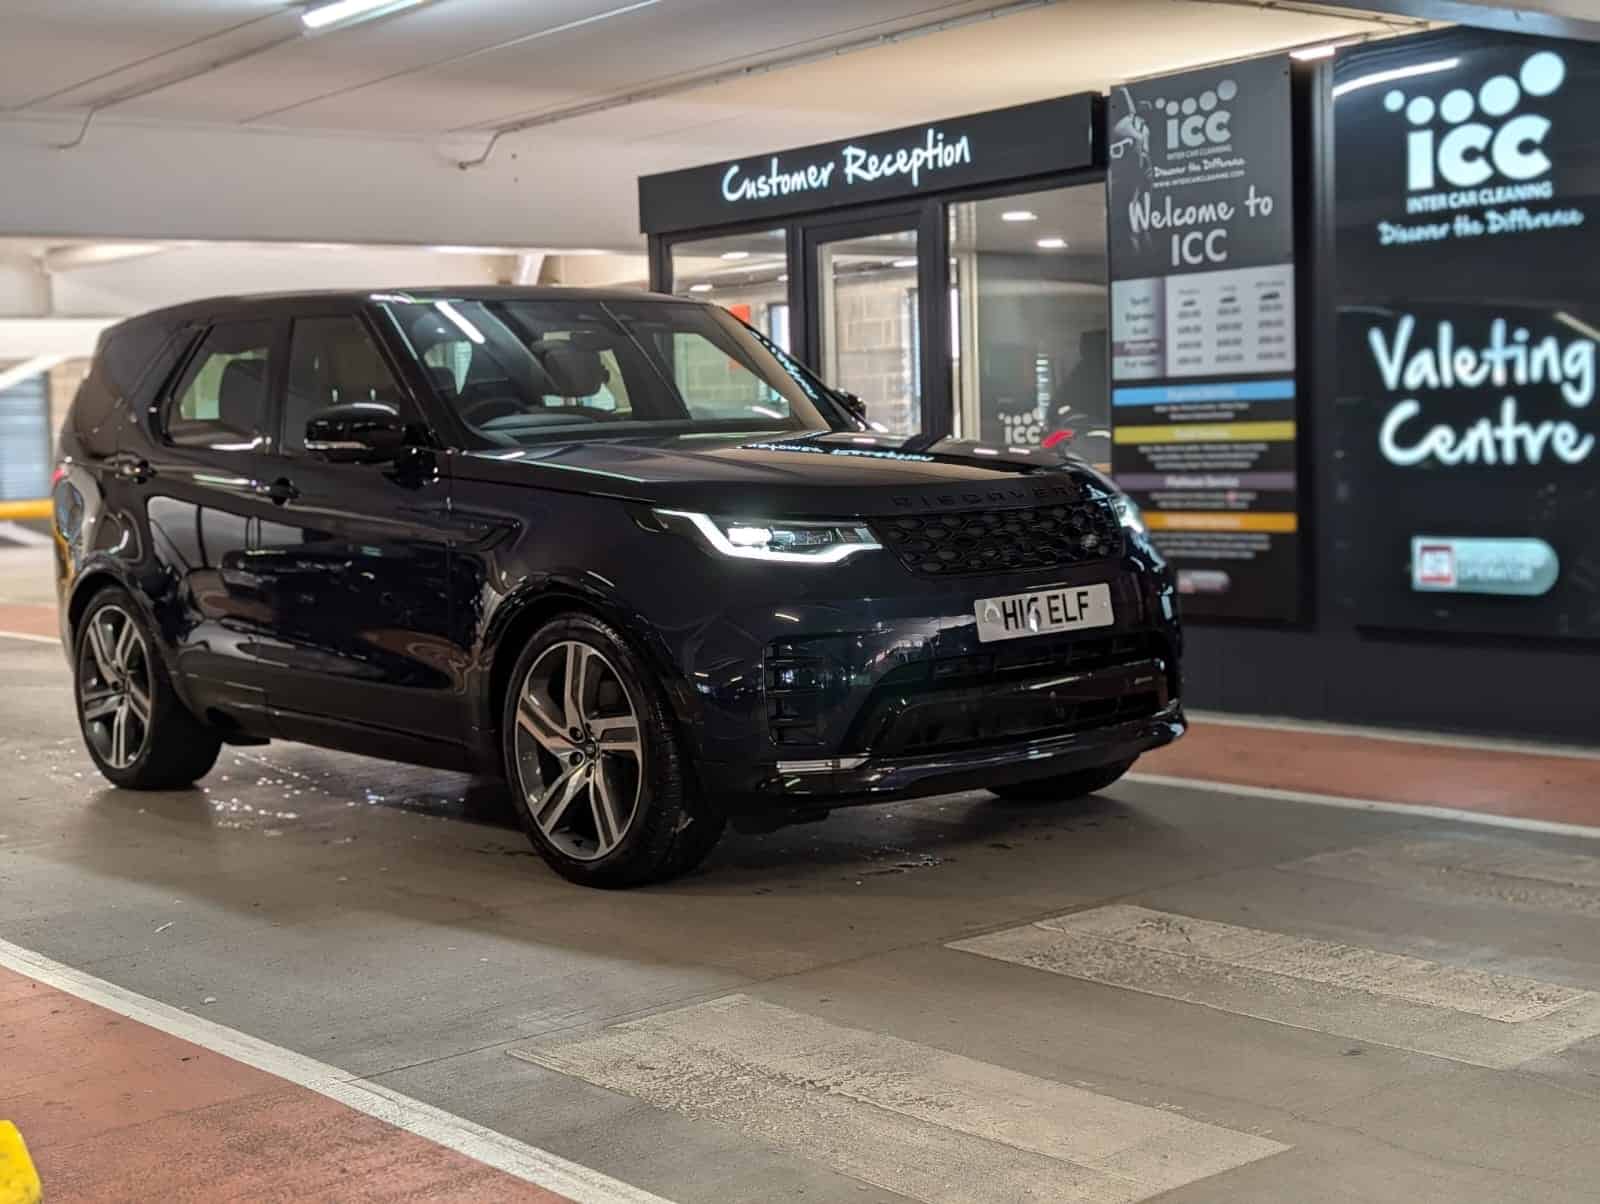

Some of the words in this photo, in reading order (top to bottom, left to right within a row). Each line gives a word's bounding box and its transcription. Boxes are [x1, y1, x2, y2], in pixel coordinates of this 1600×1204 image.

[721, 157, 835, 203] Customer
[842, 126, 971, 187] Reception
[1129, 191, 1235, 235] Welcome
[1243, 184, 1273, 217] to
[1406, 192, 1447, 215] INTER
[1449, 188, 1479, 209] CAR
[1480, 180, 1554, 206] CLEANING
[1170, 228, 1228, 267] ICC
[1377, 221, 1450, 246] Discover
[1453, 213, 1484, 238] the
[1485, 207, 1585, 234] Difference
[1367, 313, 1597, 408] Valeting
[1380, 394, 1596, 466] Centre
[1046, 590, 1090, 625] ELF
